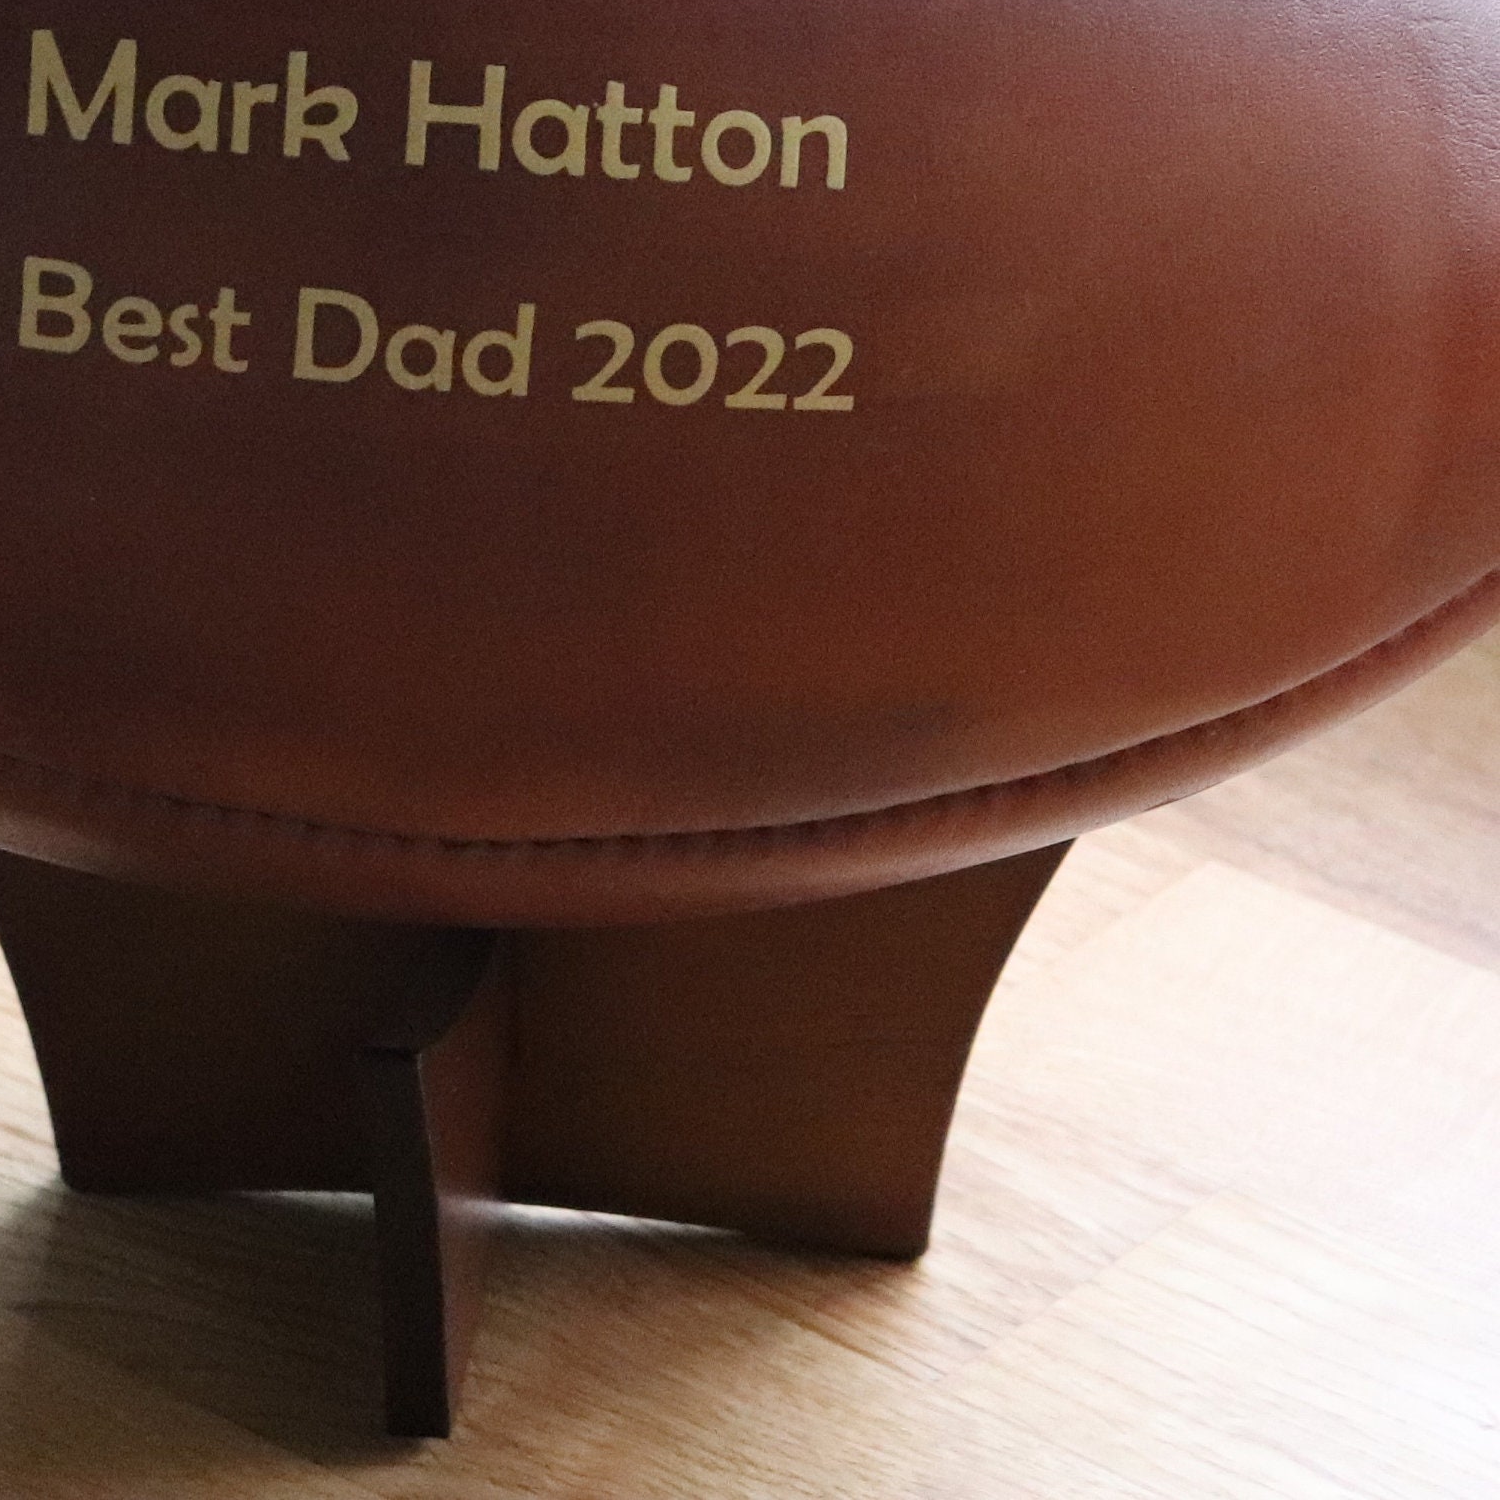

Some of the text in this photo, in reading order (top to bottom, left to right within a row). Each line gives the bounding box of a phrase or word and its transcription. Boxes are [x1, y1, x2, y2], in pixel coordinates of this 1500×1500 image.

[25, 28, 850, 191] Mark Hatton
[17, 255, 856, 412] Best Dad 2022
